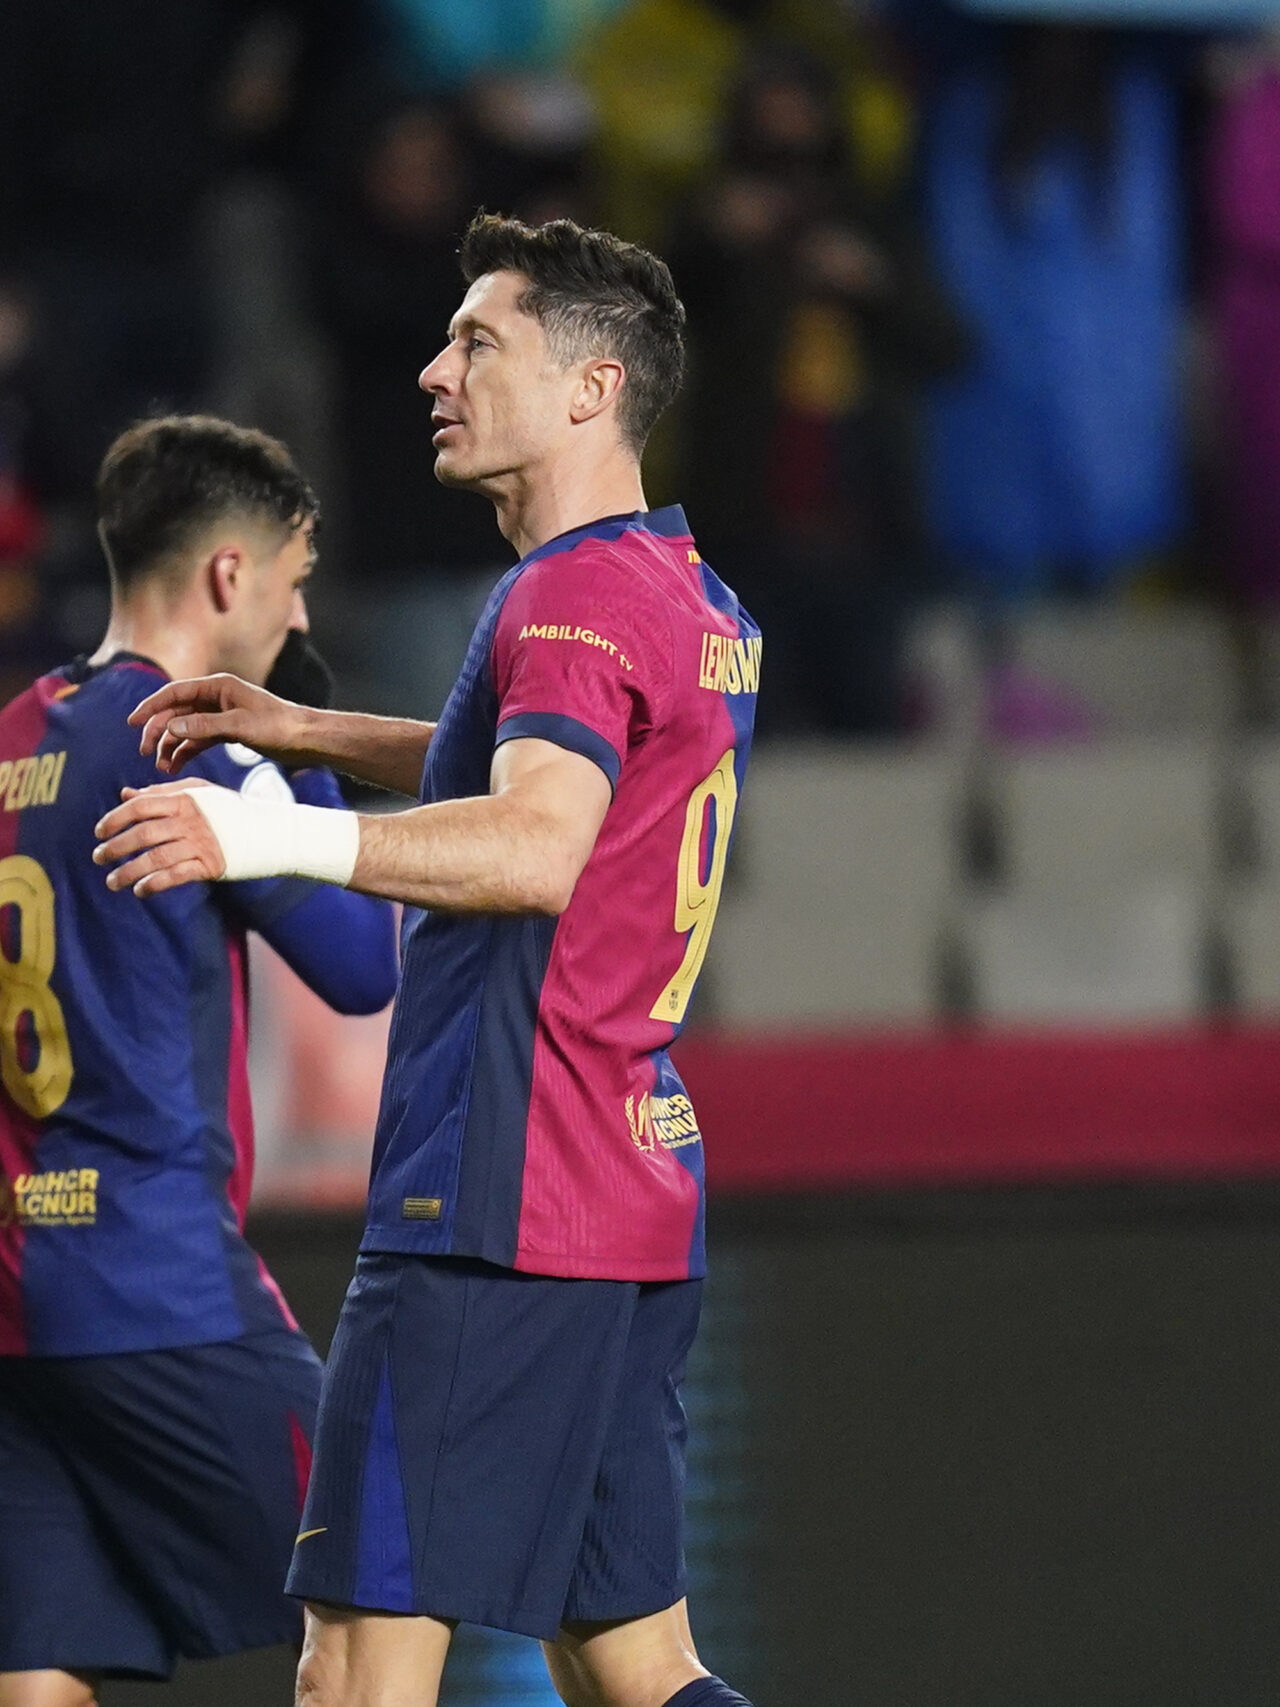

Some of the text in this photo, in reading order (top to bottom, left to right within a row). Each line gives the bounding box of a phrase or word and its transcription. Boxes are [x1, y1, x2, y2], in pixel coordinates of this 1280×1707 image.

[519, 624, 634, 671] AMBILIGHT tv
[648, 748, 738, 1024] 9
[652, 1113, 698, 1141] ACNU
[14, 1168, 99, 1194] UNHCR
